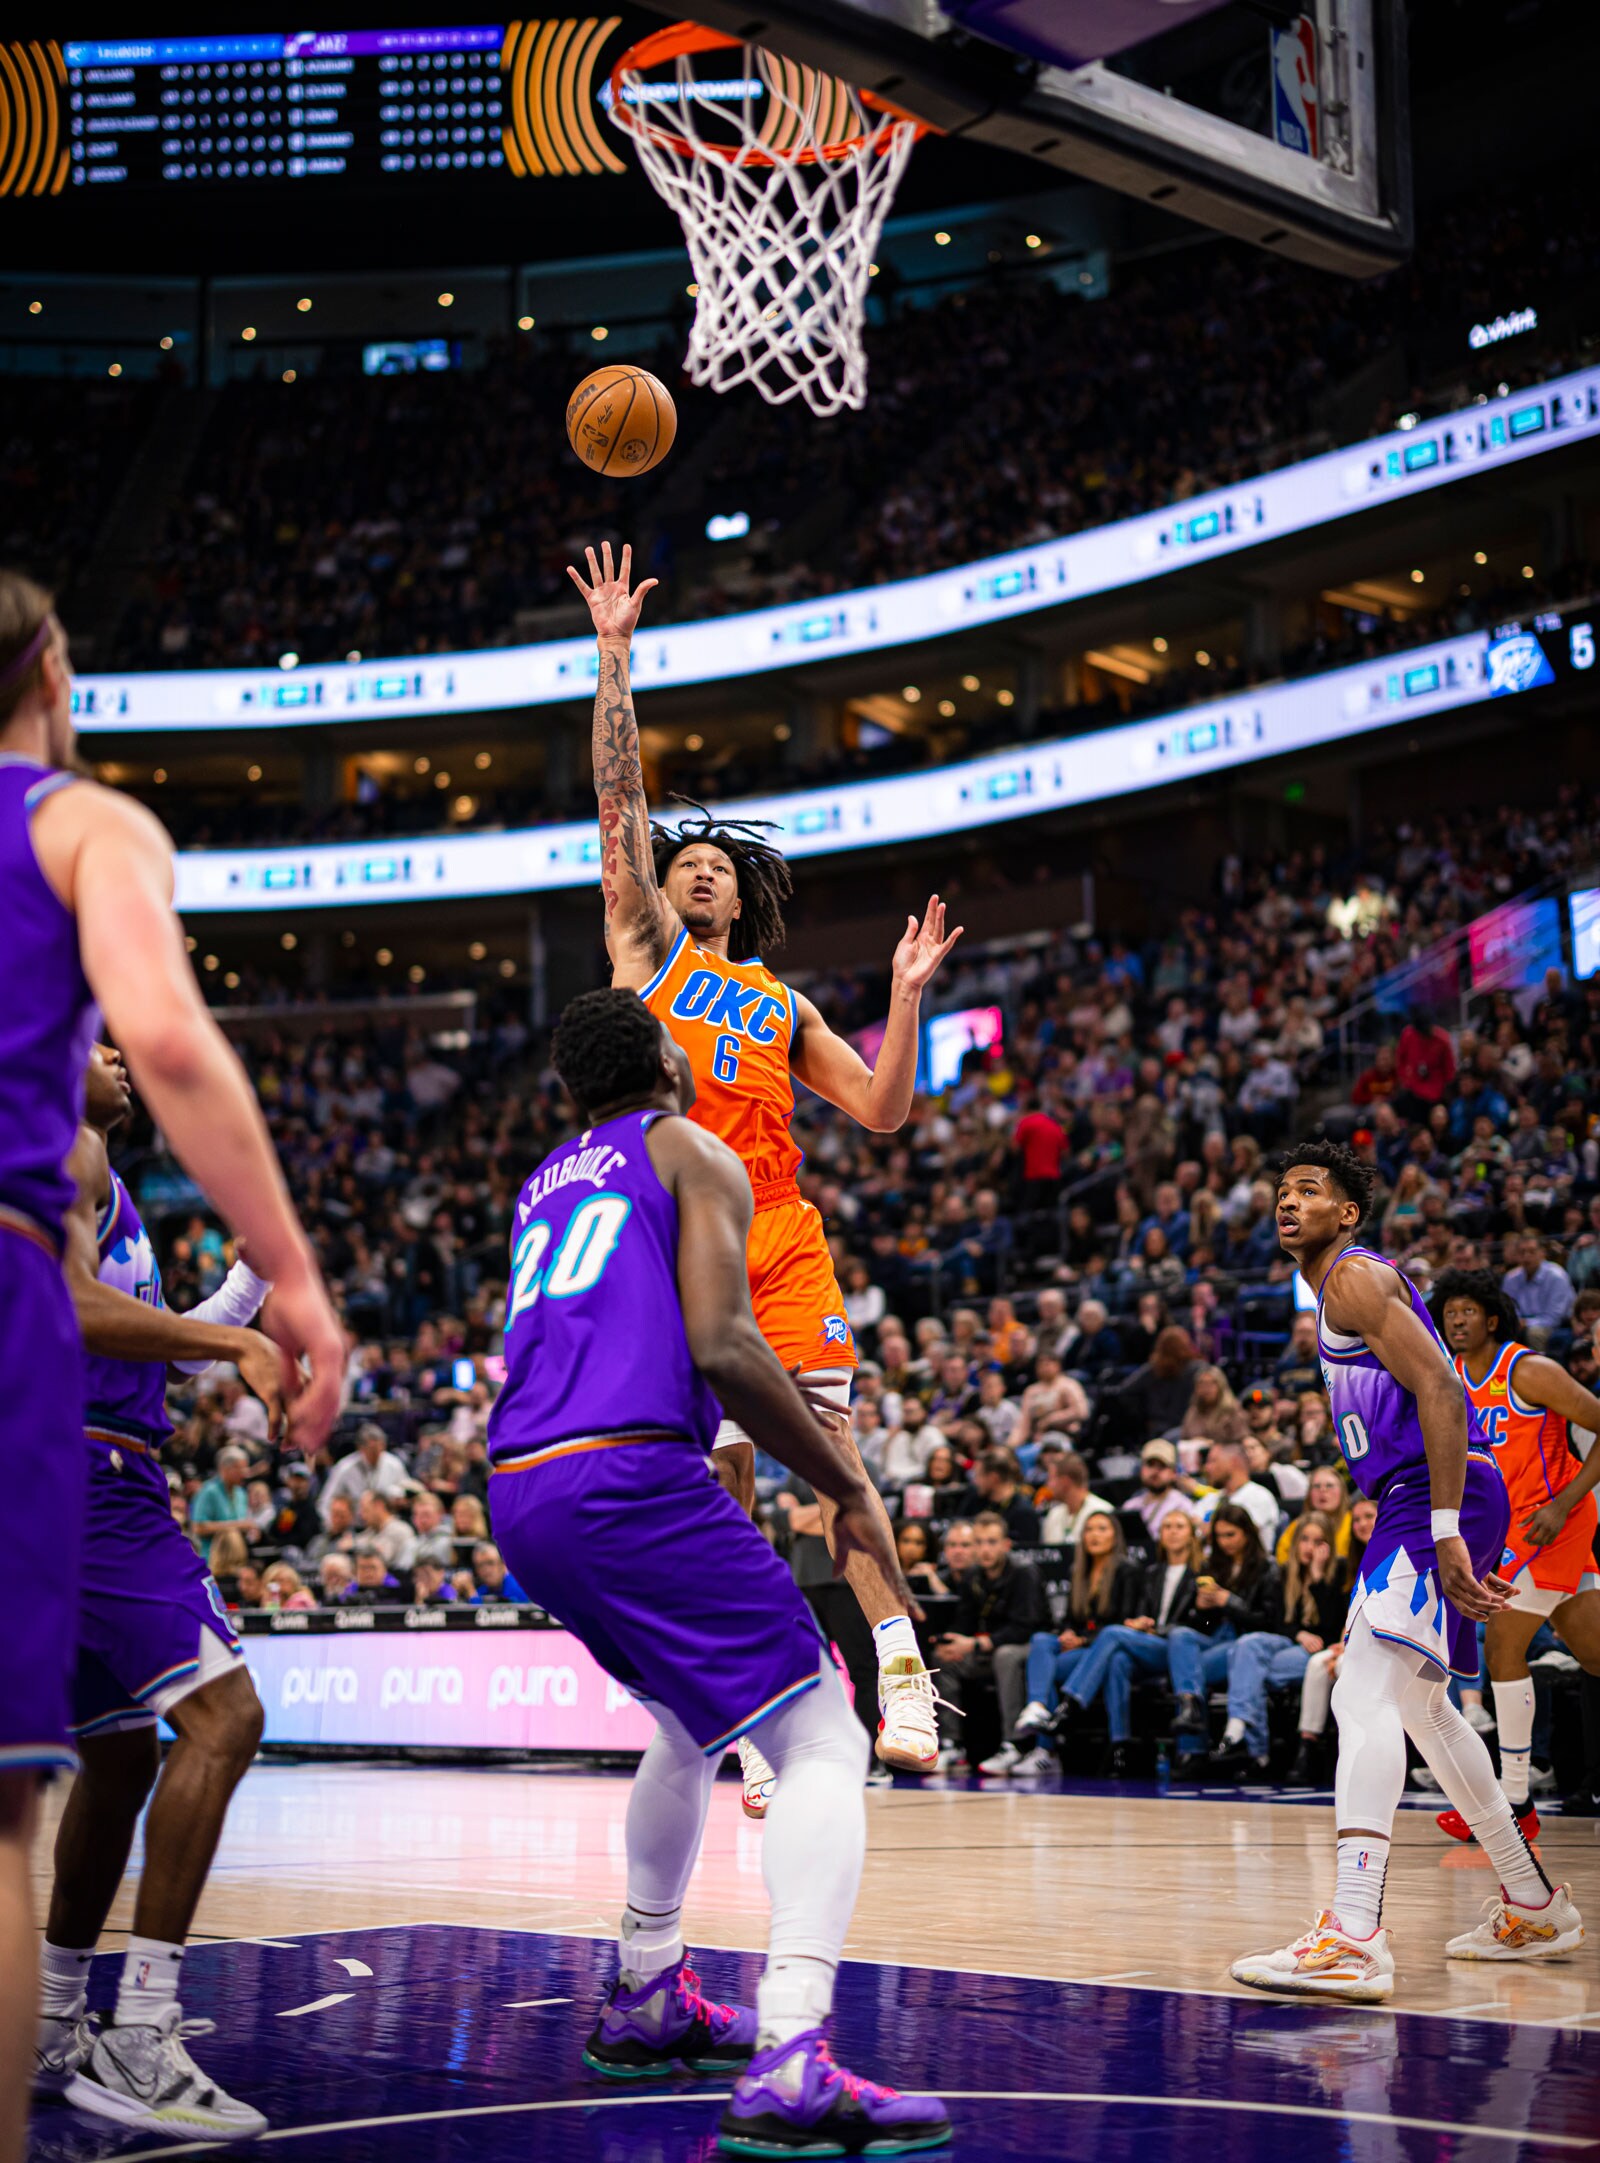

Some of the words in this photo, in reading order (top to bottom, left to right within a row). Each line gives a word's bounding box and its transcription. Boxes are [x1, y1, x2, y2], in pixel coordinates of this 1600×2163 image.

[1570, 622, 1595, 670] 5
[670, 969, 787, 1045] OKC
[712, 1033, 741, 1084] 6
[503, 1191, 632, 1332] 20
[1474, 1405, 1509, 1448] KC
[281, 1666, 358, 1709] pura
[380, 1665, 463, 1711] pura
[487, 1665, 578, 1713] pura
